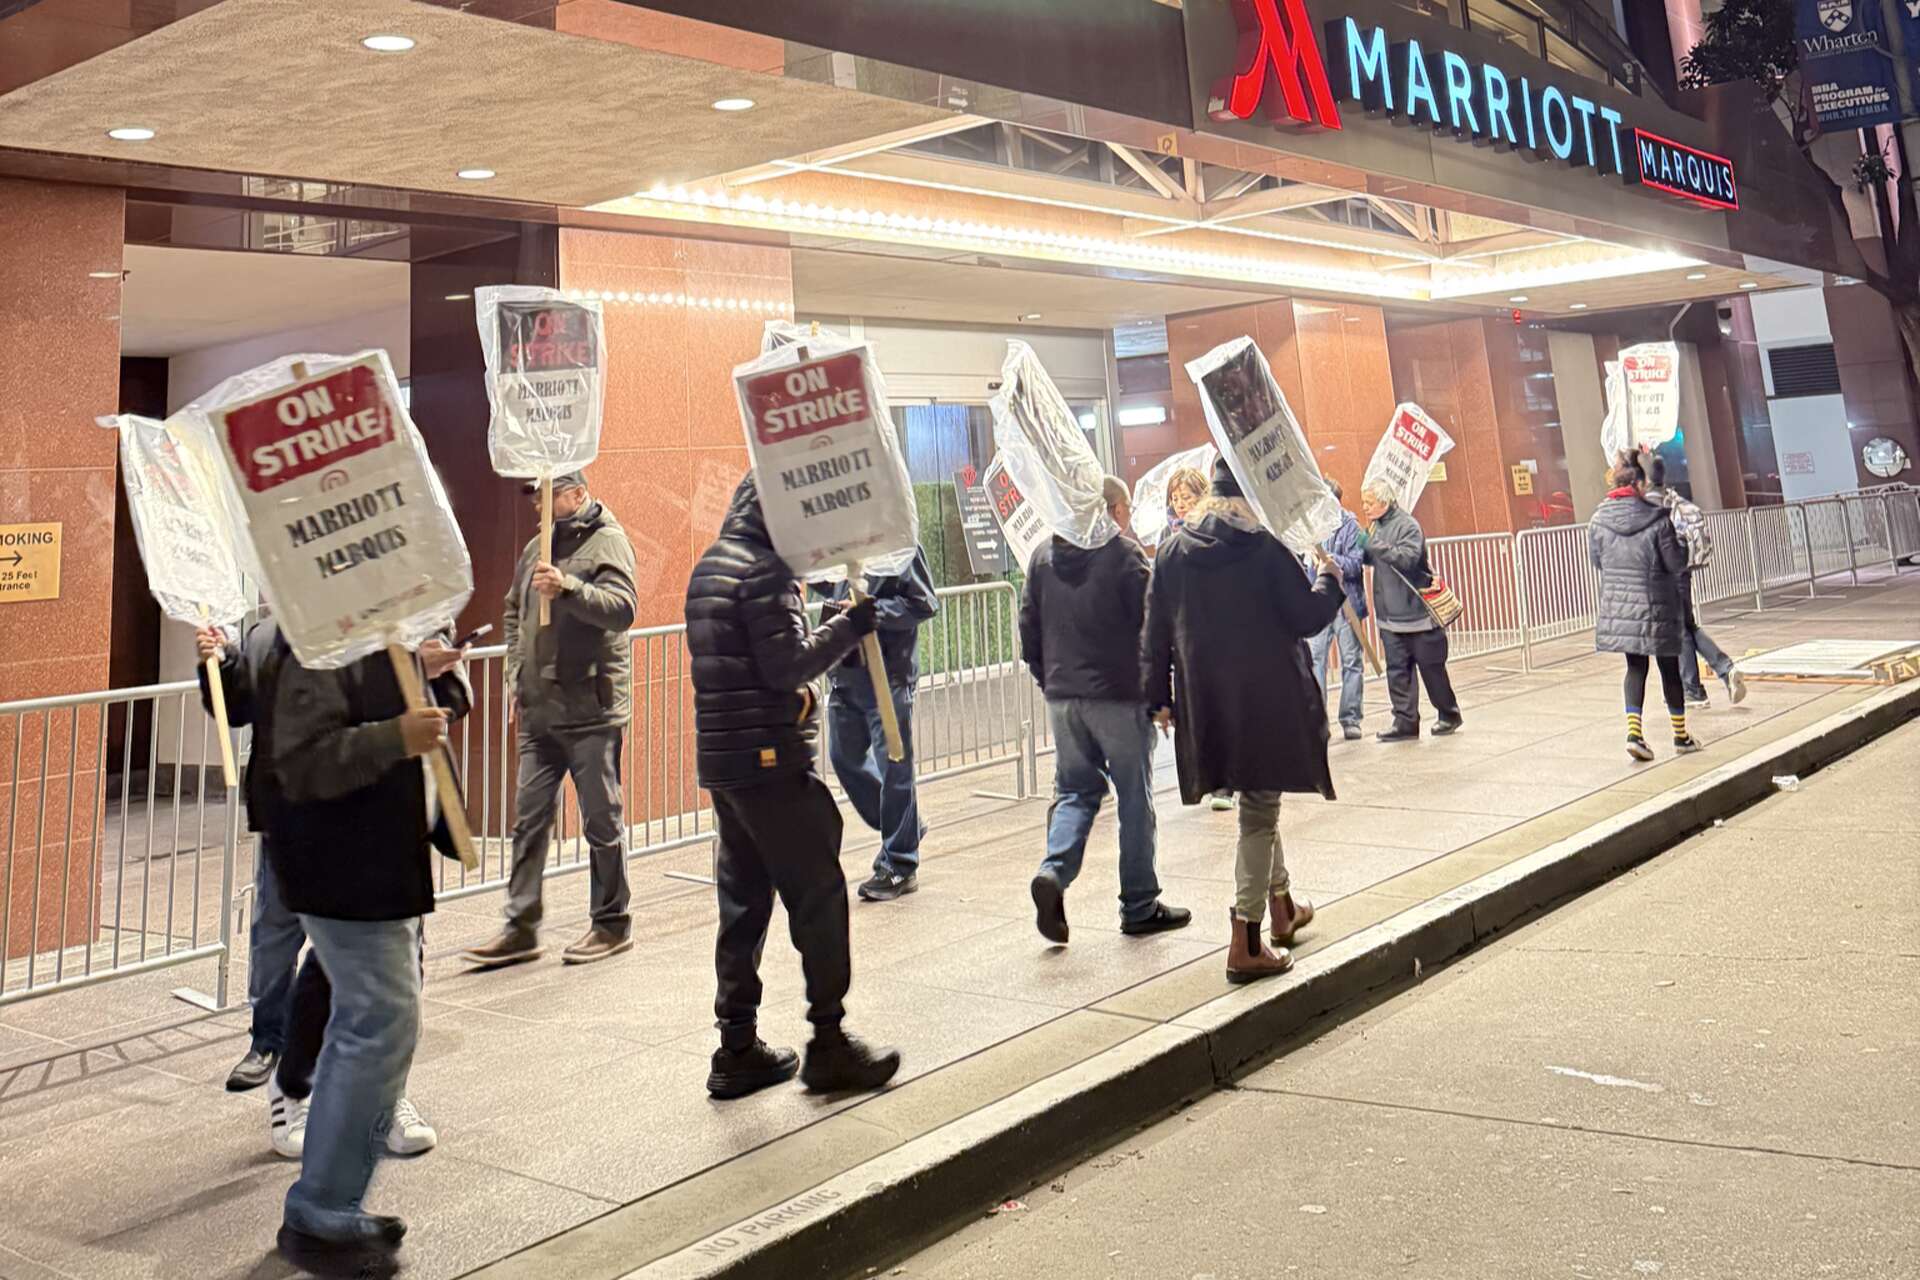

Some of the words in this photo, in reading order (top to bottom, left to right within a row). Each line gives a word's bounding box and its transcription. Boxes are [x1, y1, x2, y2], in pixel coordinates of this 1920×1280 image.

[1804, 30, 1878, 53] Wharton
[1345, 16, 1622, 175] MARRIOTT
[1811, 82, 1839, 94] MBA
[1813, 85, 1873, 103] PROGRAM
[1815, 92, 1890, 112] EXECUTIVES
[1640, 139, 1734, 200] MARQUIS
[534, 311, 567, 336] ON
[511, 340, 591, 369] STRIKE
[517, 379, 579, 400] MARRIOTT
[785, 366, 829, 397] ON
[276, 385, 335, 427] ON
[763, 388, 864, 434] STRIKE
[252, 407, 383, 477] STRIKE
[1395, 426, 1432, 457] STRIKE
[1411, 422, 1427, 438] ON
[781, 447, 872, 491] MARRIOTT
[284, 481, 406, 548] MARRIOTT
[800, 481, 872, 519] MARQUIS
[998, 486, 1021, 518] STR
[314, 524, 407, 579] MARQUIS
[2, 571, 14, 581] 25
[696, 1236, 740, 1257] NO
[738, 1189, 842, 1236] PARKING
